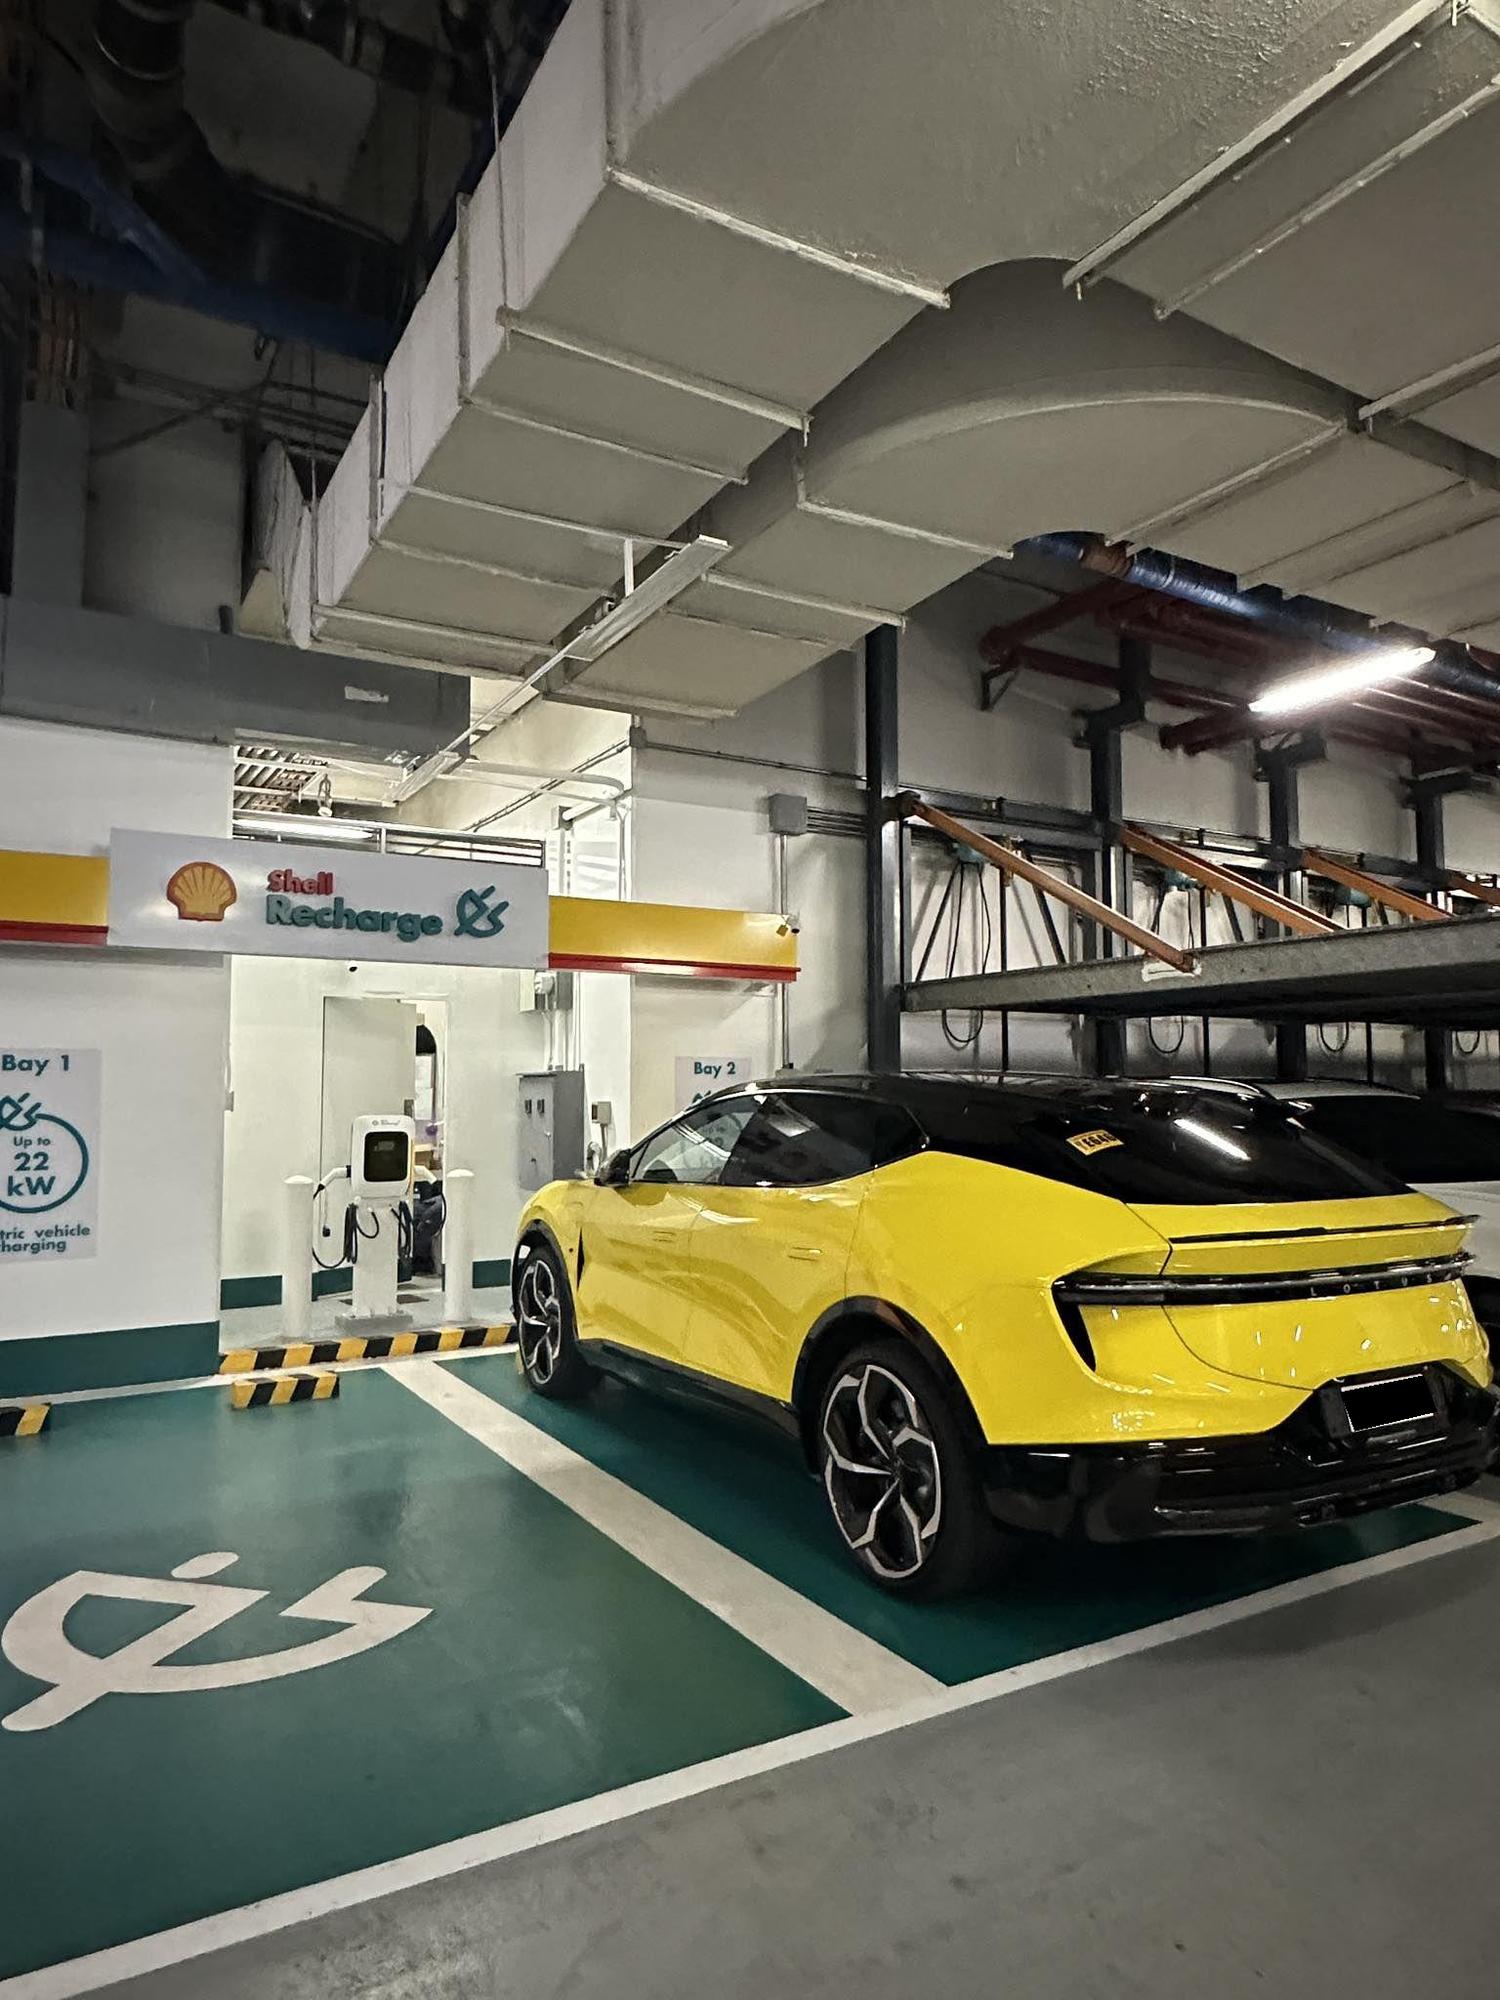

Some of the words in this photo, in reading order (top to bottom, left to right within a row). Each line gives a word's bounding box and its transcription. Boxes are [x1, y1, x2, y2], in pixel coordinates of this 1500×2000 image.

[267, 869, 334, 895] Shell
[266, 894, 444, 943] Recharge
[2, 1054, 50, 1076] Bay
[61, 1054, 69, 1071] 1
[694, 1061, 721, 1078] Bay
[727, 1061, 736, 1074] 2
[13, 1136, 33, 1149] Up
[37, 1136, 52, 1146] to
[14, 1151, 49, 1171] 22
[8, 1175, 56, 1196] kW
[35, 1223, 91, 1238] vehicle
[0, 1238, 67, 1254] harging
[1310, 1274, 1433, 1297] LOTUS
